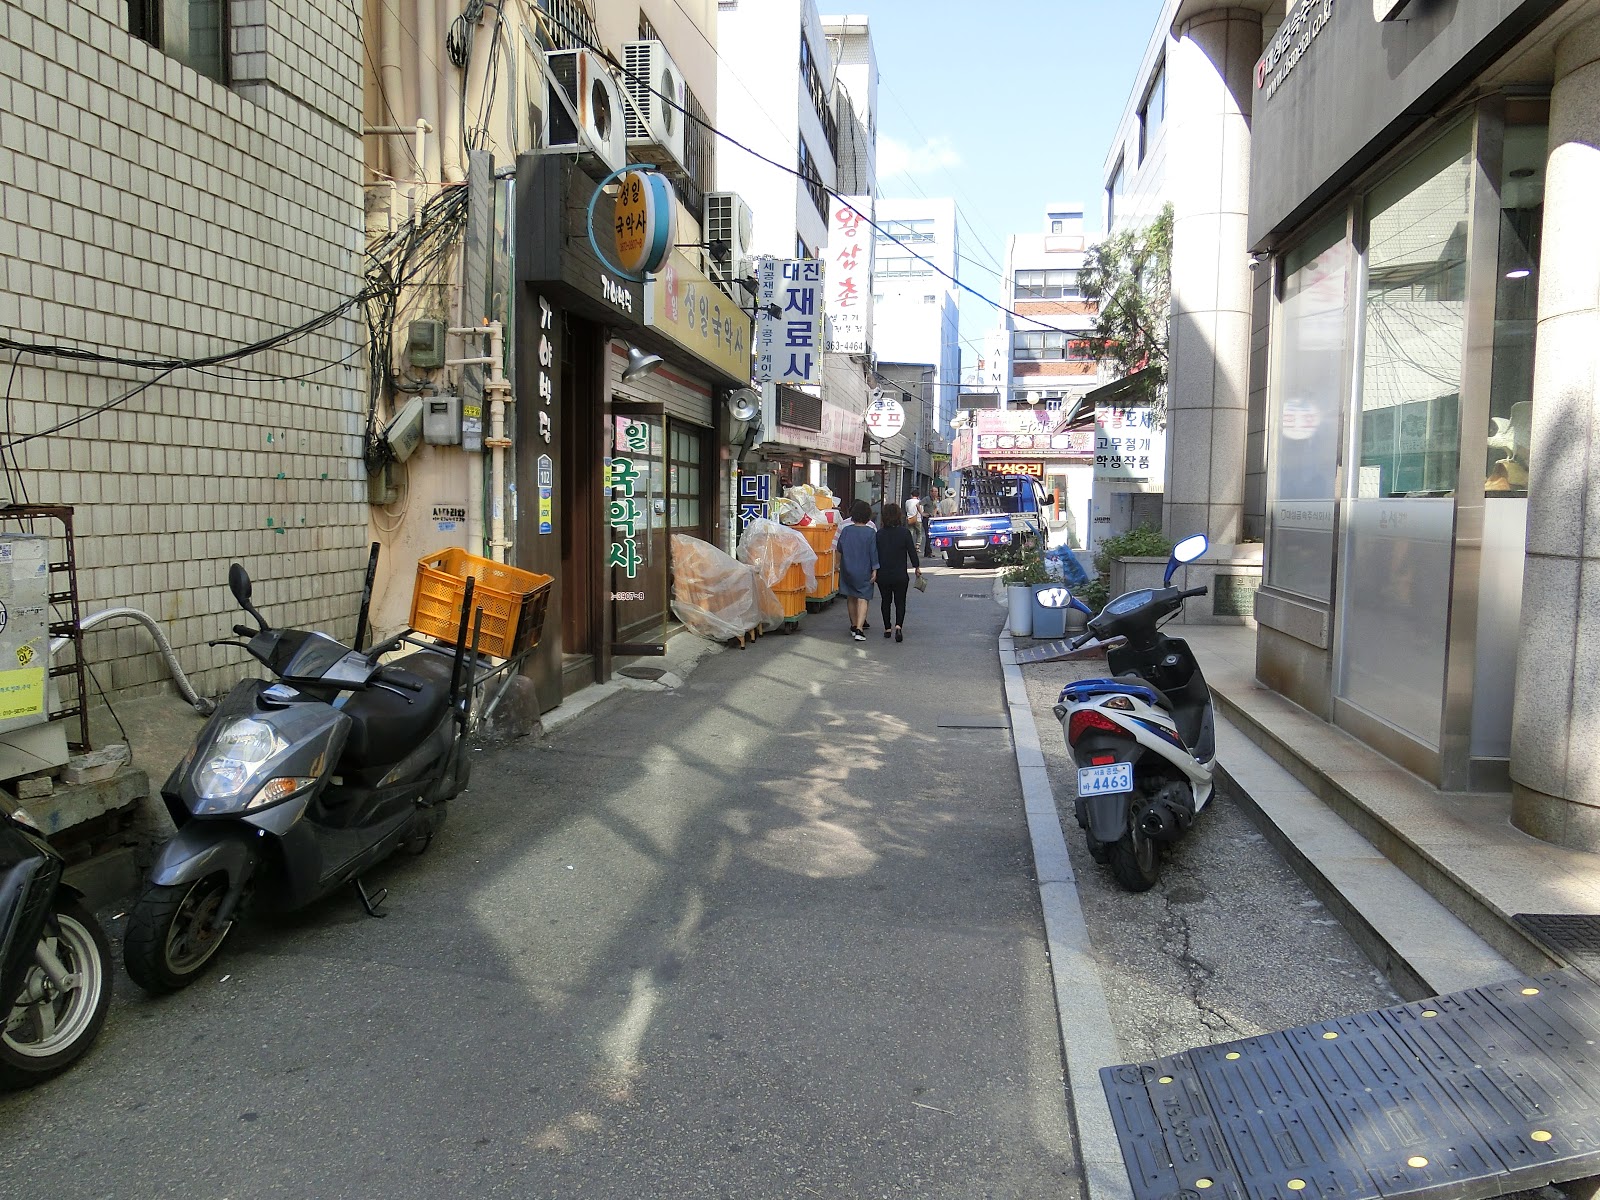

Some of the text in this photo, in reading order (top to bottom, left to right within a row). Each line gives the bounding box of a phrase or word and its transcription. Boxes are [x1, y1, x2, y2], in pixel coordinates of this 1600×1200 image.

[620, 178, 640, 207] 성일
[615, 209, 646, 239] 국악사
[782, 263, 819, 281] 대진
[665, 266, 679, 321] 성일
[685, 282, 744, 364] 성일국악사
[783, 287, 815, 380] 재료사
[538, 294, 553, 444] 가야빌딩
[867, 412, 901, 427] 호프
[1096, 437, 1151, 452] 고무절개
[1096, 455, 1150, 469] 학생작품
[611, 456, 643, 579] 국악사
[1082, 774, 1129, 791] 바 4463
[1093, 768, 1105, 776] 서울
